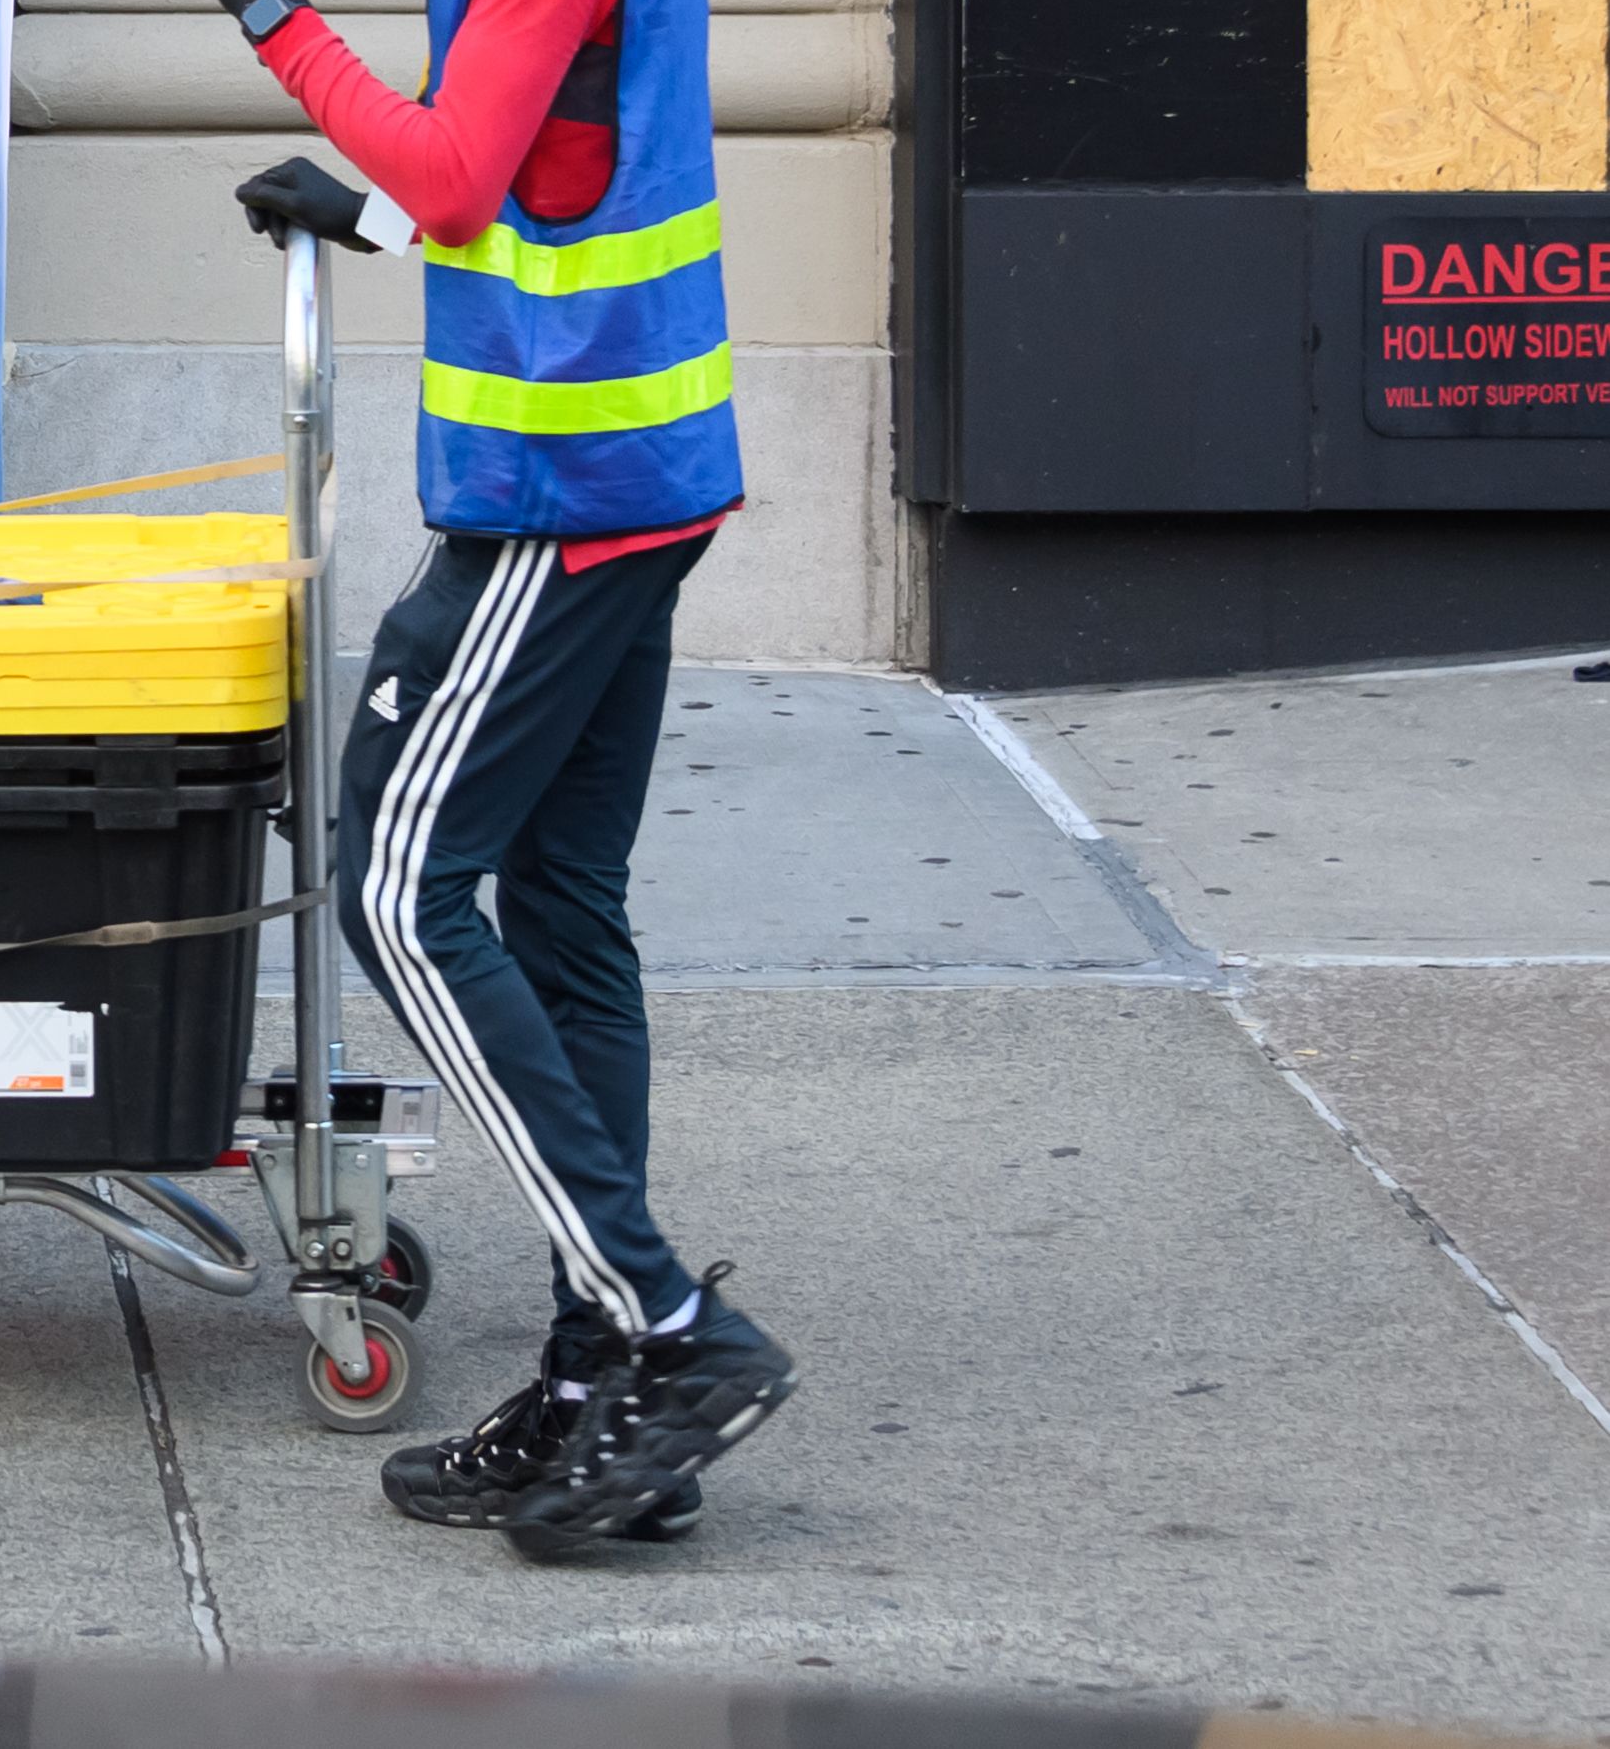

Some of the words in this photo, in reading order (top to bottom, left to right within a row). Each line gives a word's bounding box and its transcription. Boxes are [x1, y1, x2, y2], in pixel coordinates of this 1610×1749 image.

[1383, 324, 1517, 361] HOLLOW
[1384, 386, 1434, 408] WILL
[1438, 385, 1480, 407] NOT
[1485, 383, 1581, 406] SUPPORT
